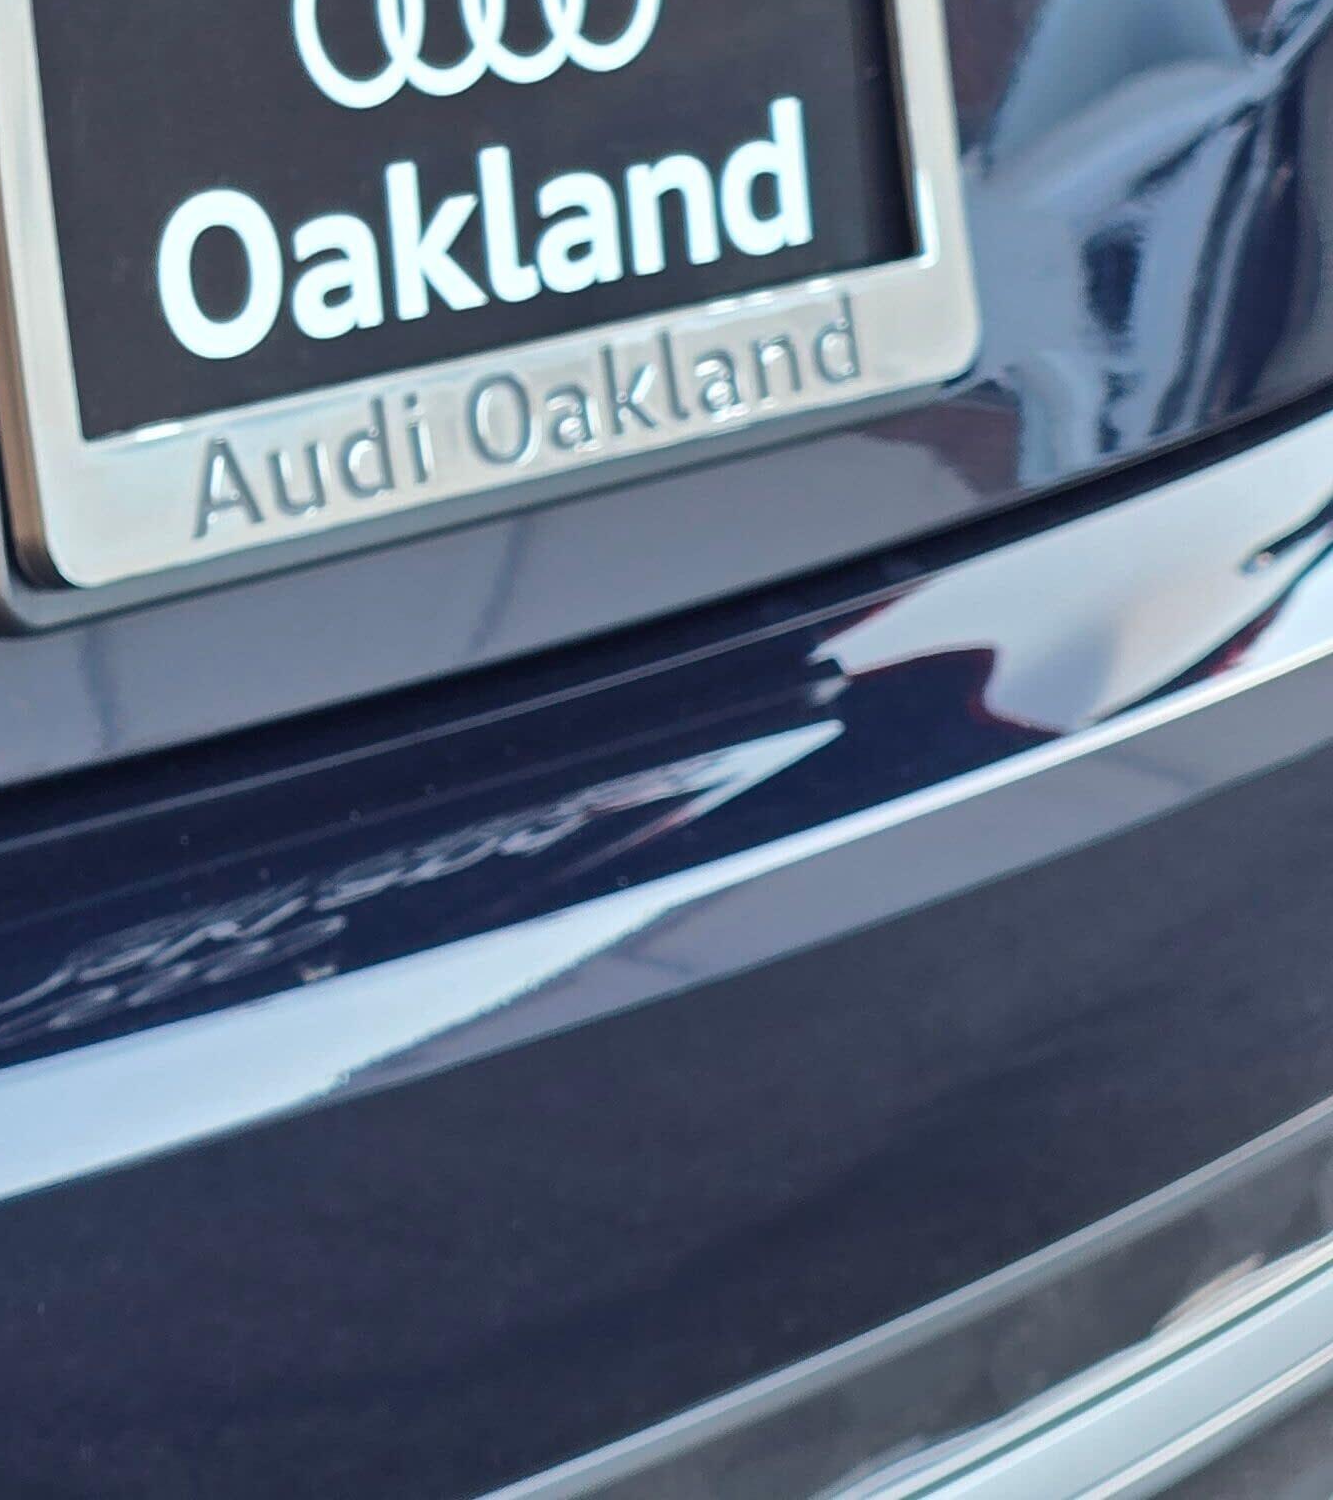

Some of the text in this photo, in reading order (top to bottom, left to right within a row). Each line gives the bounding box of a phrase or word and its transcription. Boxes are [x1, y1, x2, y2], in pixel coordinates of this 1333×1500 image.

[157, 96, 813, 360] Oakland
[191, 294, 862, 540] Audi Oakland
